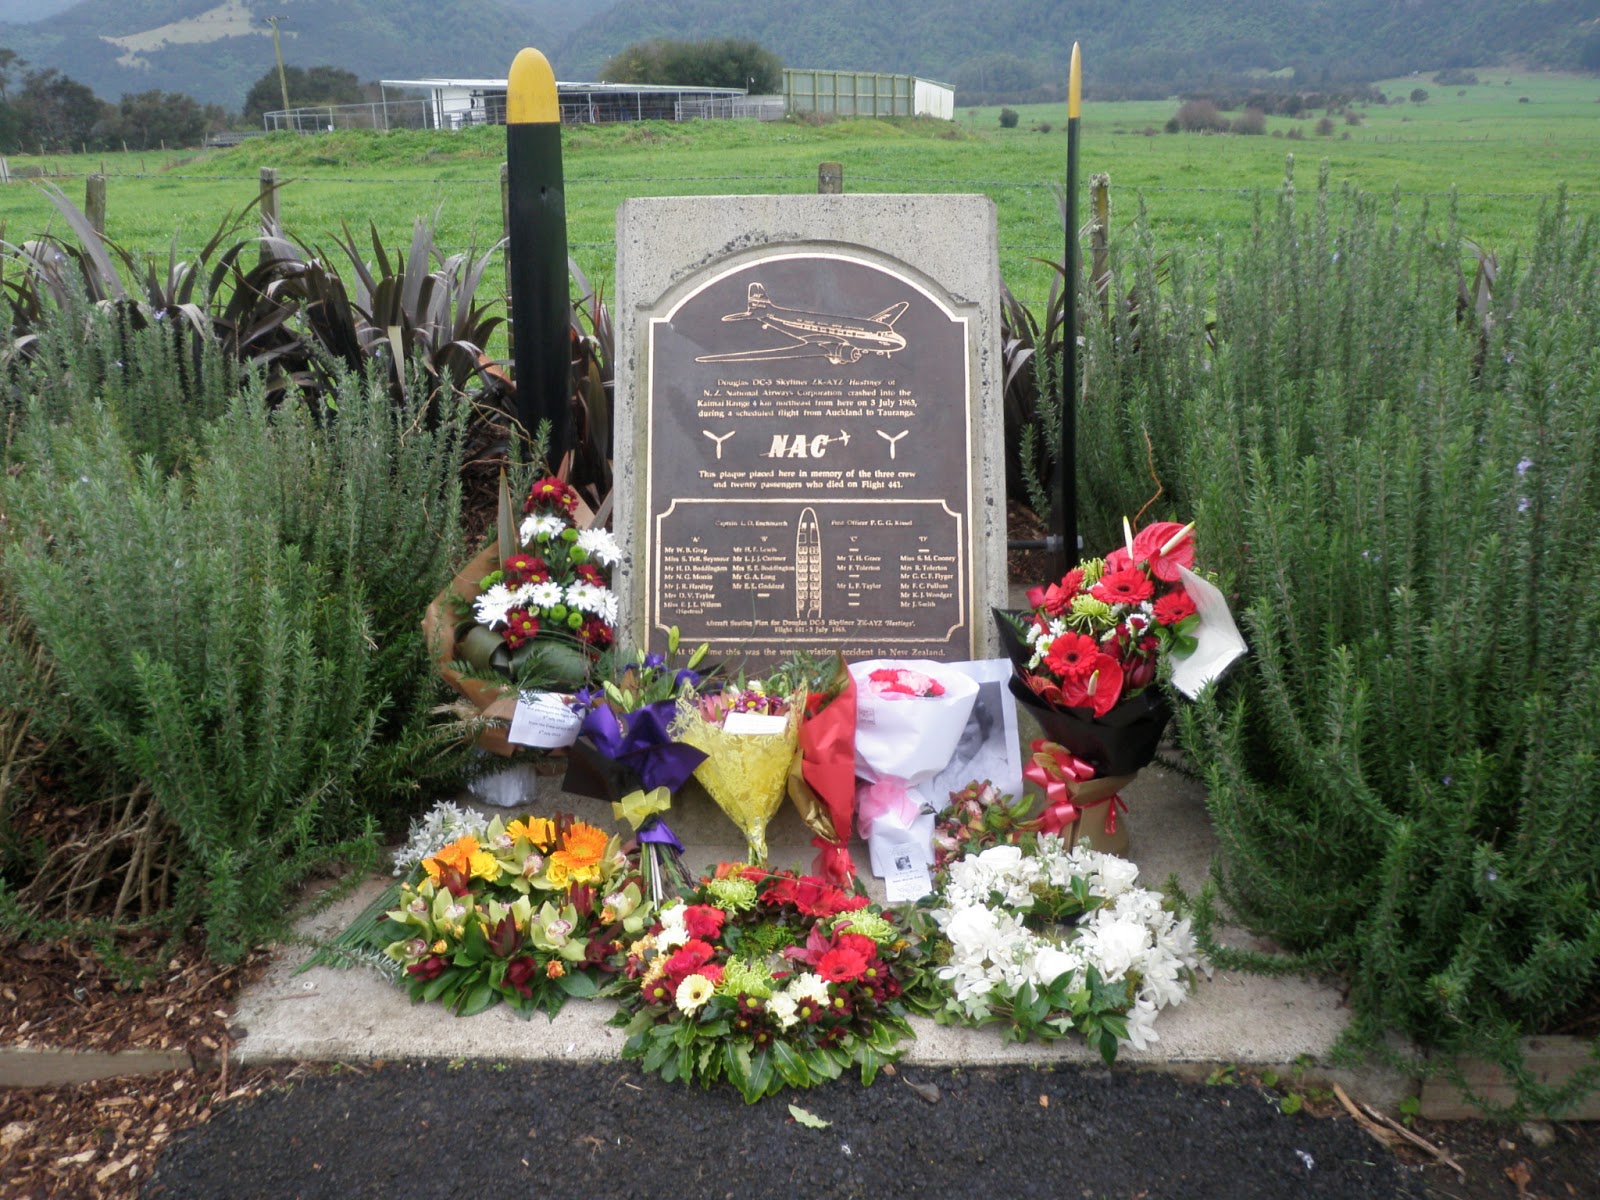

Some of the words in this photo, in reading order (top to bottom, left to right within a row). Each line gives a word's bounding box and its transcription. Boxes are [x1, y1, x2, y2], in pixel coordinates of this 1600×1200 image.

[698, 409, 725, 418] during
[778, 409, 799, 417] flight
[877, 409, 915, 418] Tauranga.
[768, 434, 829, 458] NAC
[720, 471, 746, 479] plaque
[749, 470, 774, 479] placed
[811, 471, 843, 480] memory
[846, 469, 855, 478] of
[859, 470, 871, 478] the
[875, 470, 895, 478] three
[806, 480, 823, 488] who
[826, 480, 844, 488] died
[862, 480, 885, 490] Flight
[674, 648, 685, 656] At
[764, 648, 776, 656] the
[841, 648, 874, 656] accident
[889, 648, 908, 656] New
[912, 648, 945, 656] Zealand.
